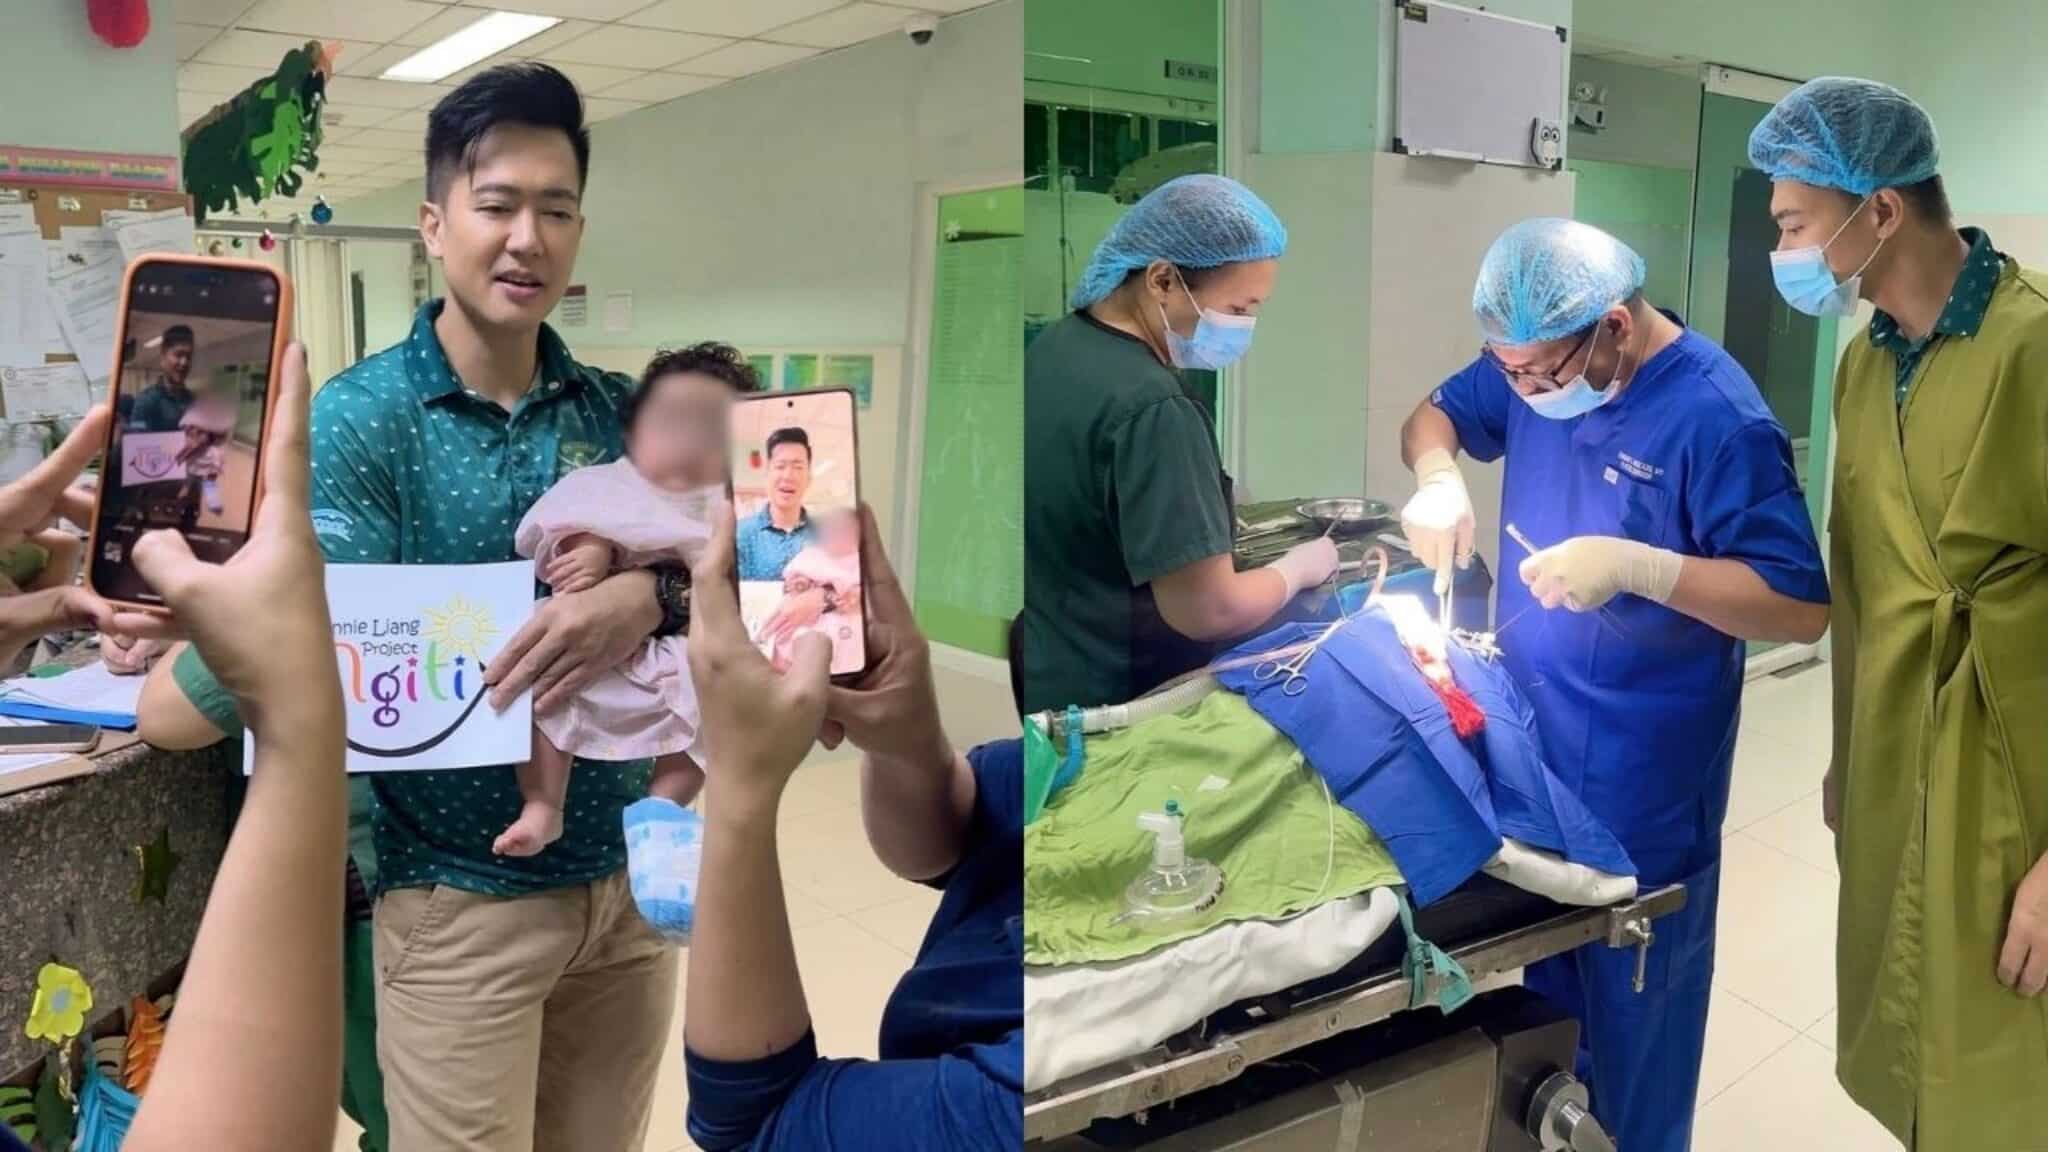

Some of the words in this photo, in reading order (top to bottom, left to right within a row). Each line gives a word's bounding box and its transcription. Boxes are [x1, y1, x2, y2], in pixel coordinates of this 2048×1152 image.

[332, 619, 368, 635] nnie
[371, 618, 420, 637] Liang
[361, 641, 418, 656] Project
